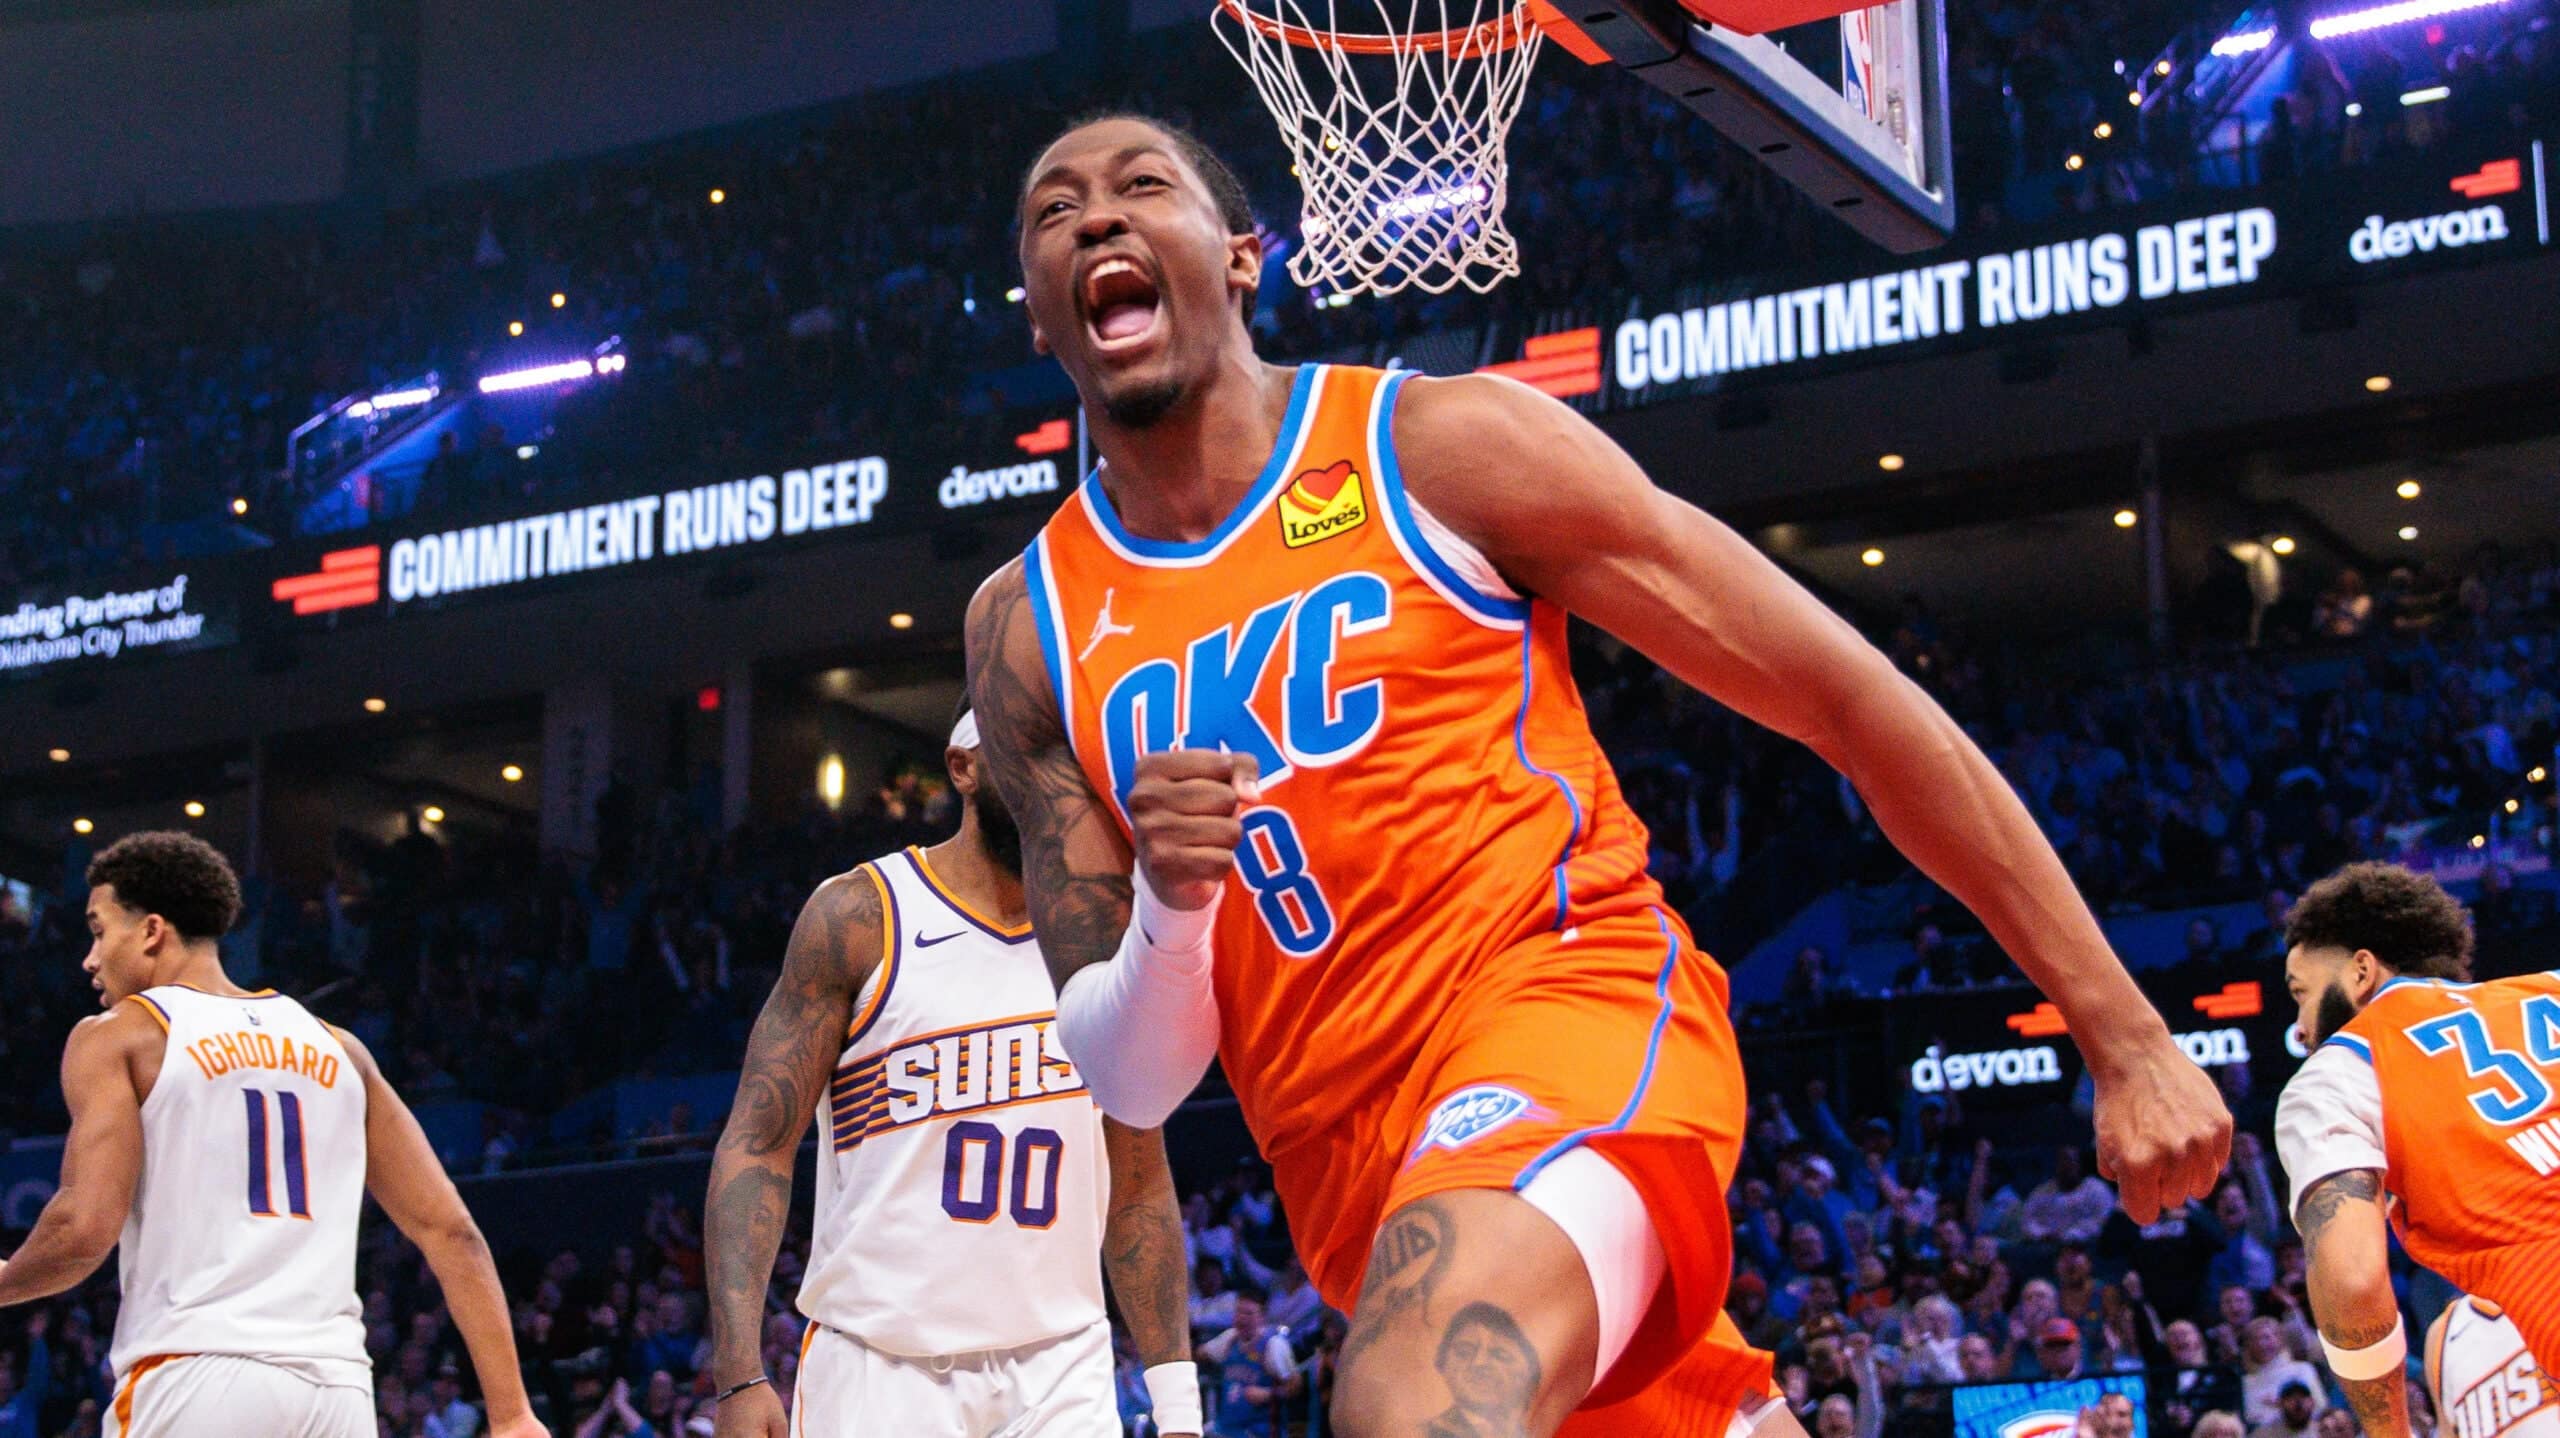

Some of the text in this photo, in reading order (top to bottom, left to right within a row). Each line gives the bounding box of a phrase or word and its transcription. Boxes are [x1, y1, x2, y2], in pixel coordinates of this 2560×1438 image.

[2350, 205, 2509, 263] devon
[1615, 207, 2276, 390] COMMITMENT RUNS DEEP
[939, 460, 1058, 508] devon
[388, 456, 888, 602] COMMITMENT RUNS DEEP
[65, 589, 157, 629] Partner
[157, 574, 188, 613] of
[82, 626, 123, 659] City
[123, 611, 205, 647] Thunder
[1102, 571, 1393, 832] OKC
[1233, 806, 1336, 957] 8
[186, 1031, 339, 1090] IGHODARO
[1911, 1045, 2062, 1093] devon
[242, 1088, 314, 1221] 11
[941, 1120, 1065, 1231] 00
